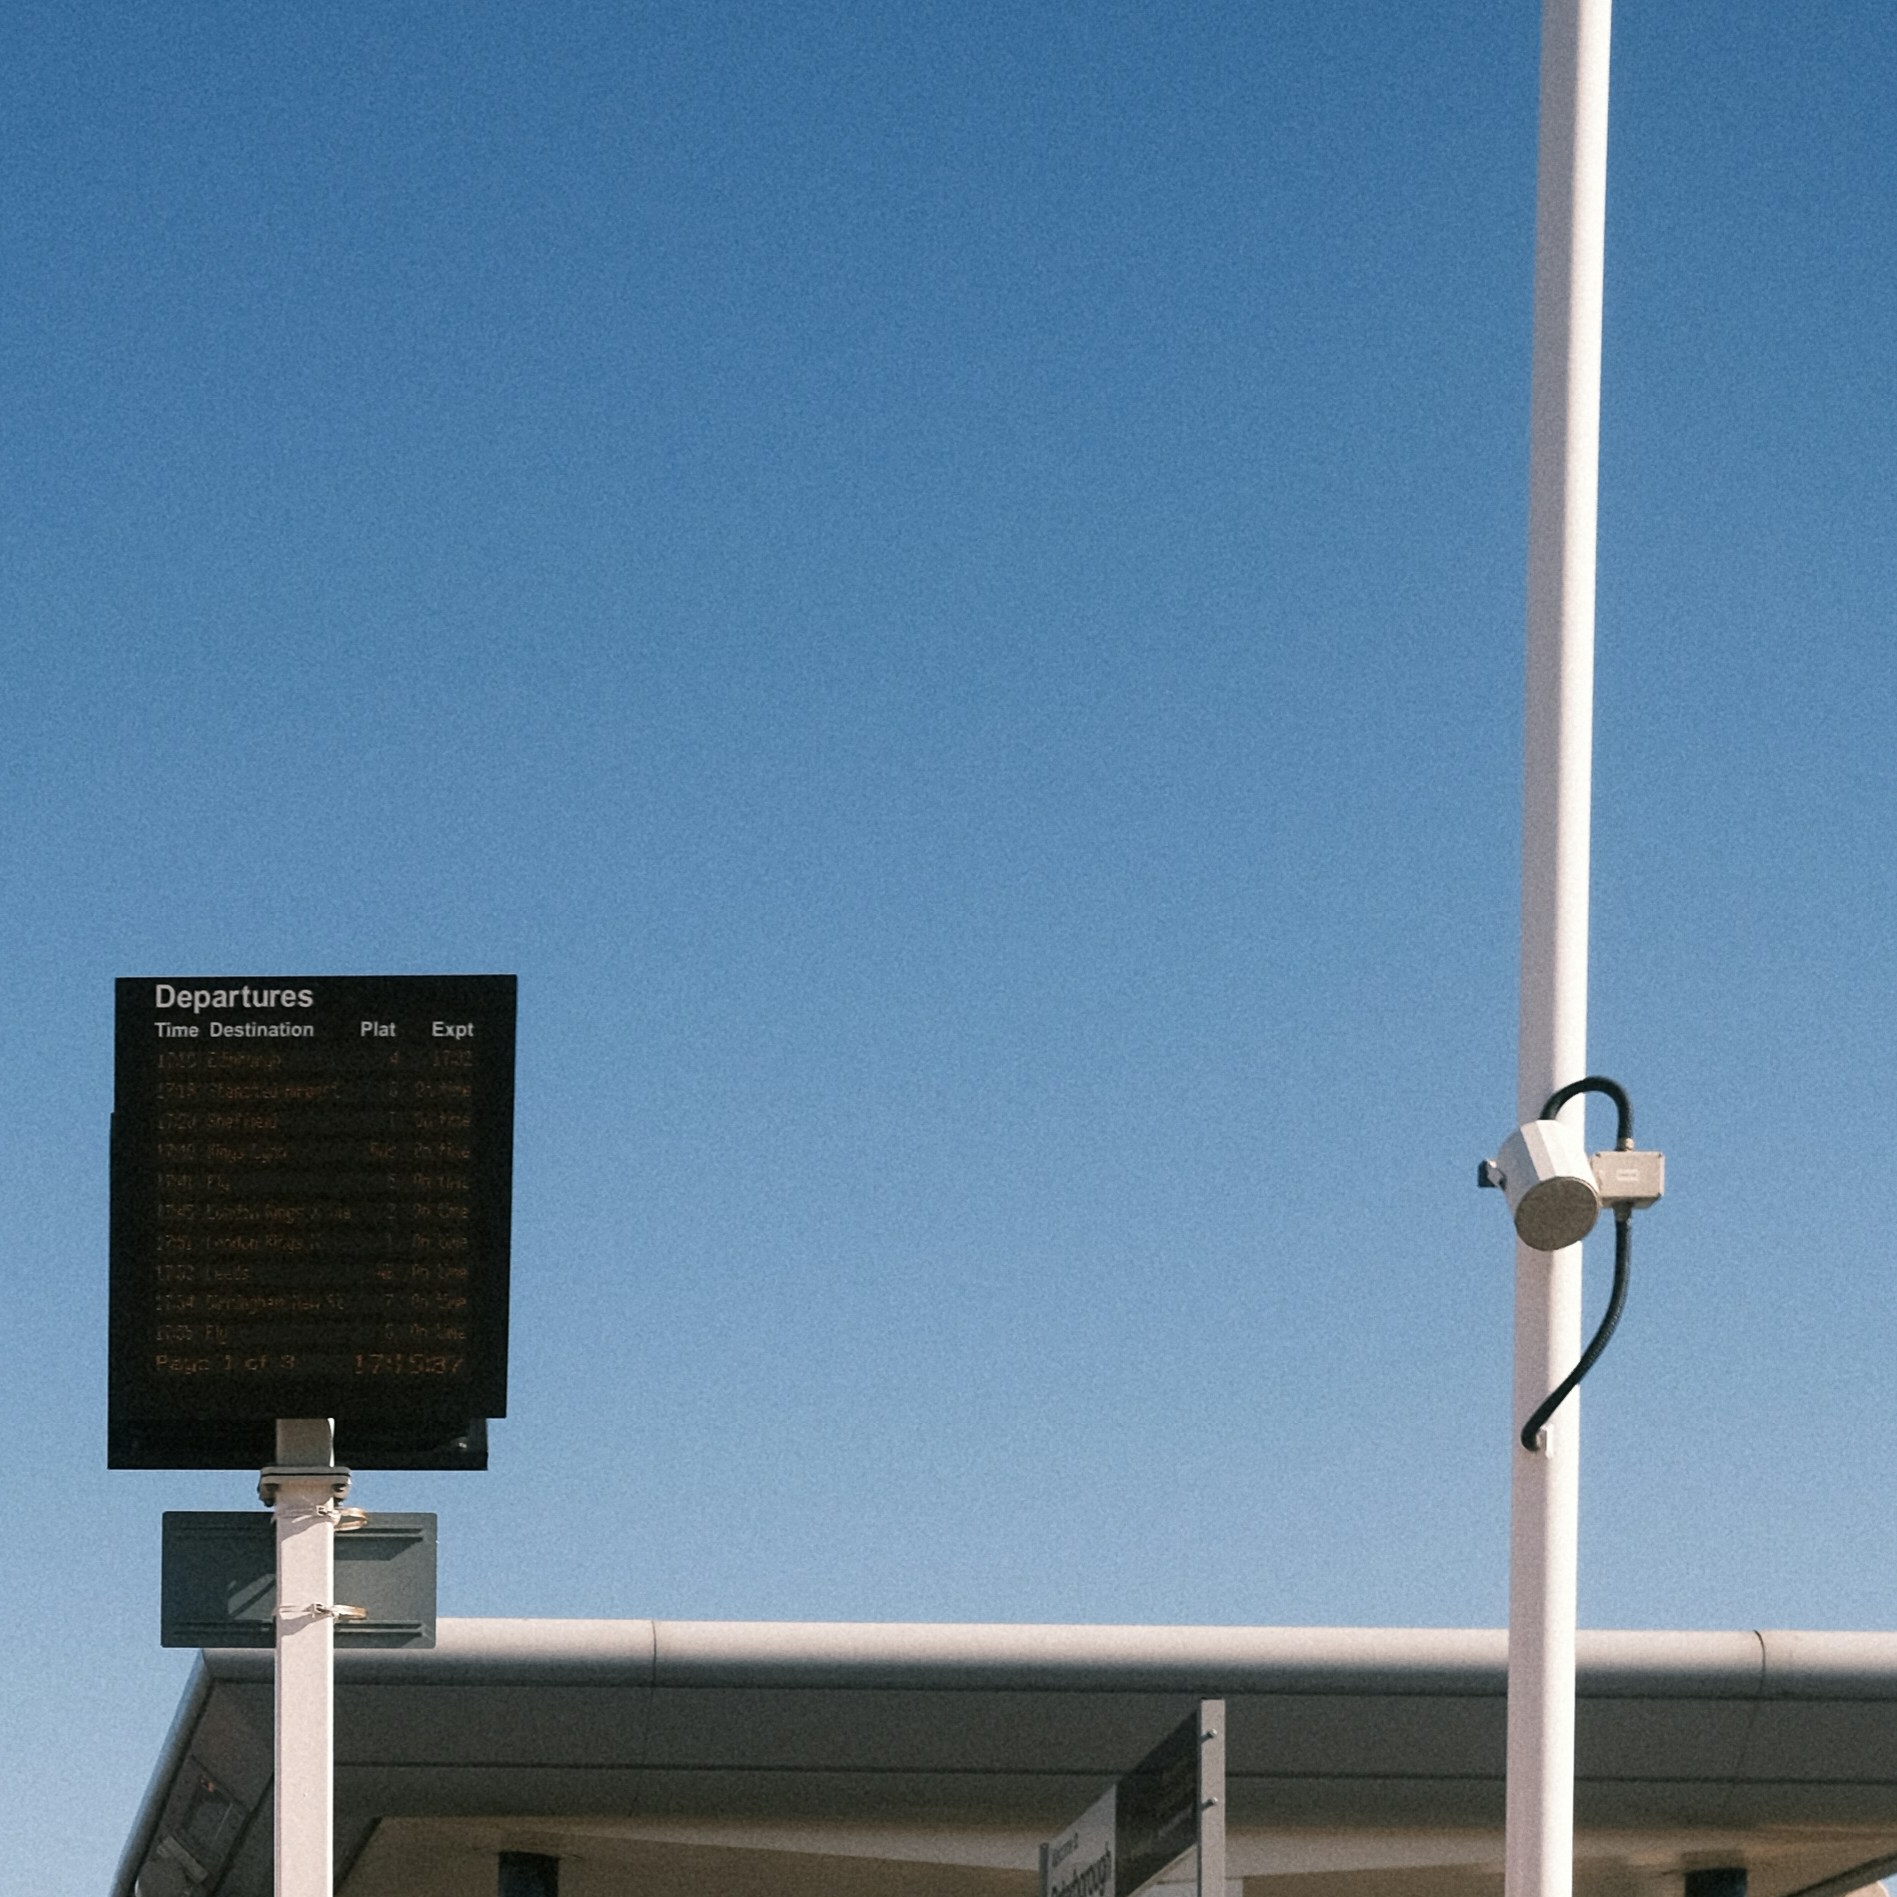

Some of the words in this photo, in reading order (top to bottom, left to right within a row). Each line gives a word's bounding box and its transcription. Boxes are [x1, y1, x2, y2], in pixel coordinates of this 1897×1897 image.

[155, 984, 314, 1014] Departures
[154, 1022, 199, 1038] Time
[210, 1021, 314, 1038] Destination
[360, 1021, 396, 1037] Plat
[432, 1021, 474, 1040] Expt
[155, 1355, 211, 1376] Page
